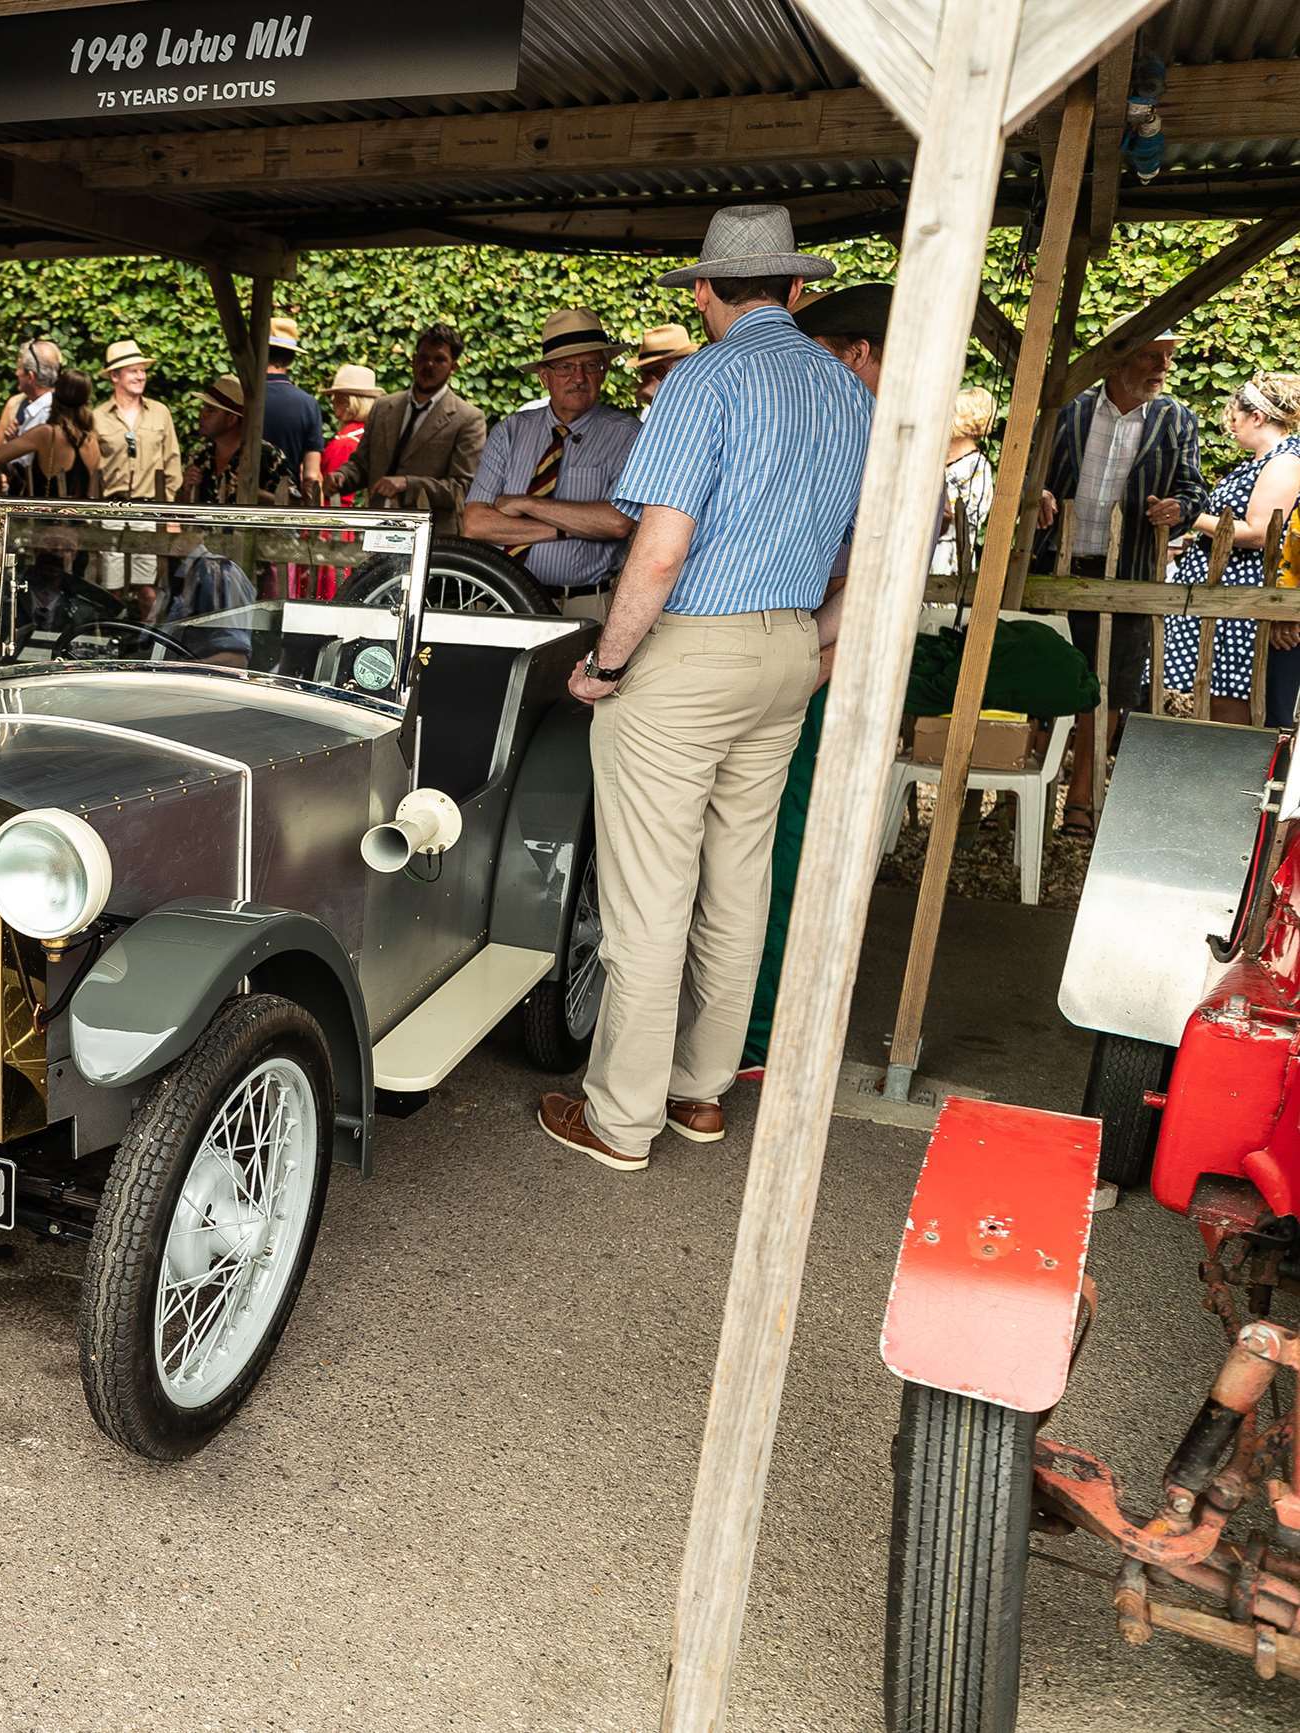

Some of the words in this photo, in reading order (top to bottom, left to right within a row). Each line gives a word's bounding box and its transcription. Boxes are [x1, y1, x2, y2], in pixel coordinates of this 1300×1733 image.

[70, 32, 148, 74] 1948
[156, 27, 236, 67] Lotus
[245, 15, 312, 60] MkI
[97, 91, 116, 108] 75
[120, 87, 178, 106] YEARS
[183, 84, 208, 102] OF
[213, 80, 276, 100] LOTUS
